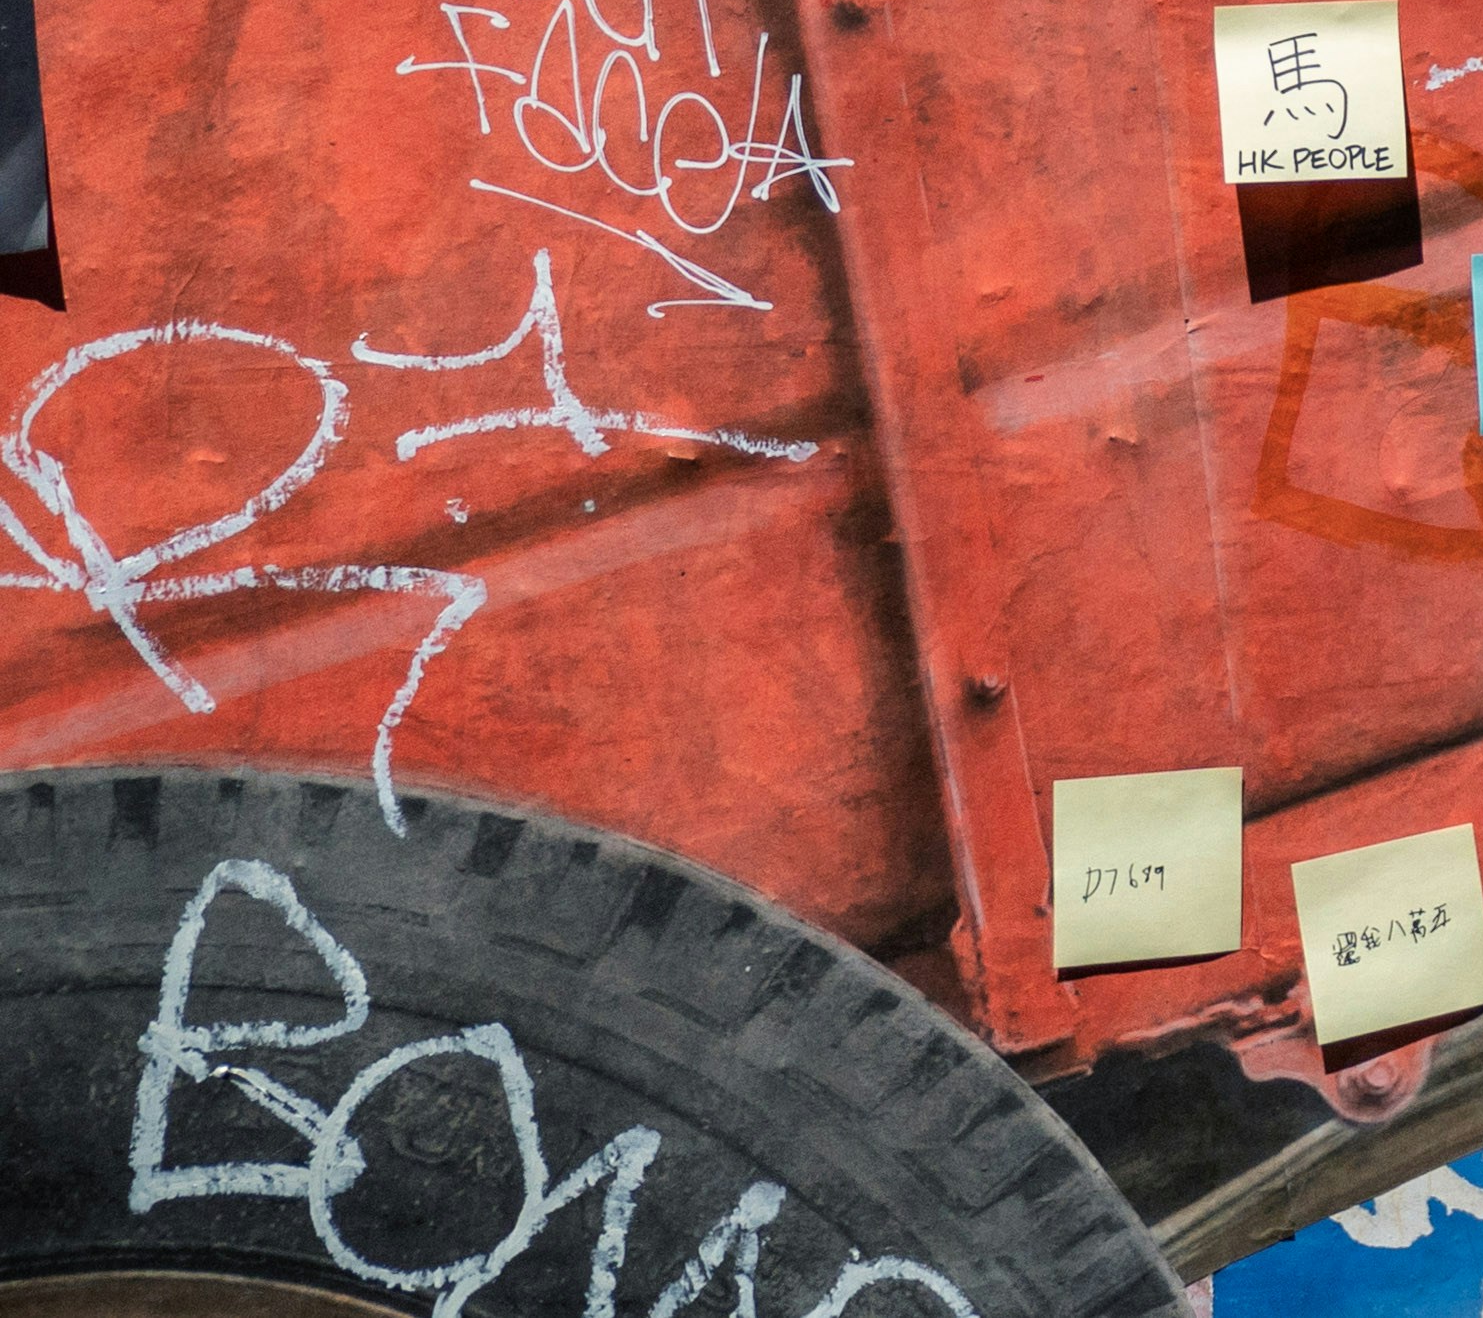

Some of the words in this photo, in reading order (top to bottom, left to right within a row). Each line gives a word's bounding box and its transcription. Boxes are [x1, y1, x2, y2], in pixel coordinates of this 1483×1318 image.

[1261, 30, 1348, 139] 馬
[1237, 148, 1285, 175] HK
[1293, 144, 1395, 175] PEOPLE
